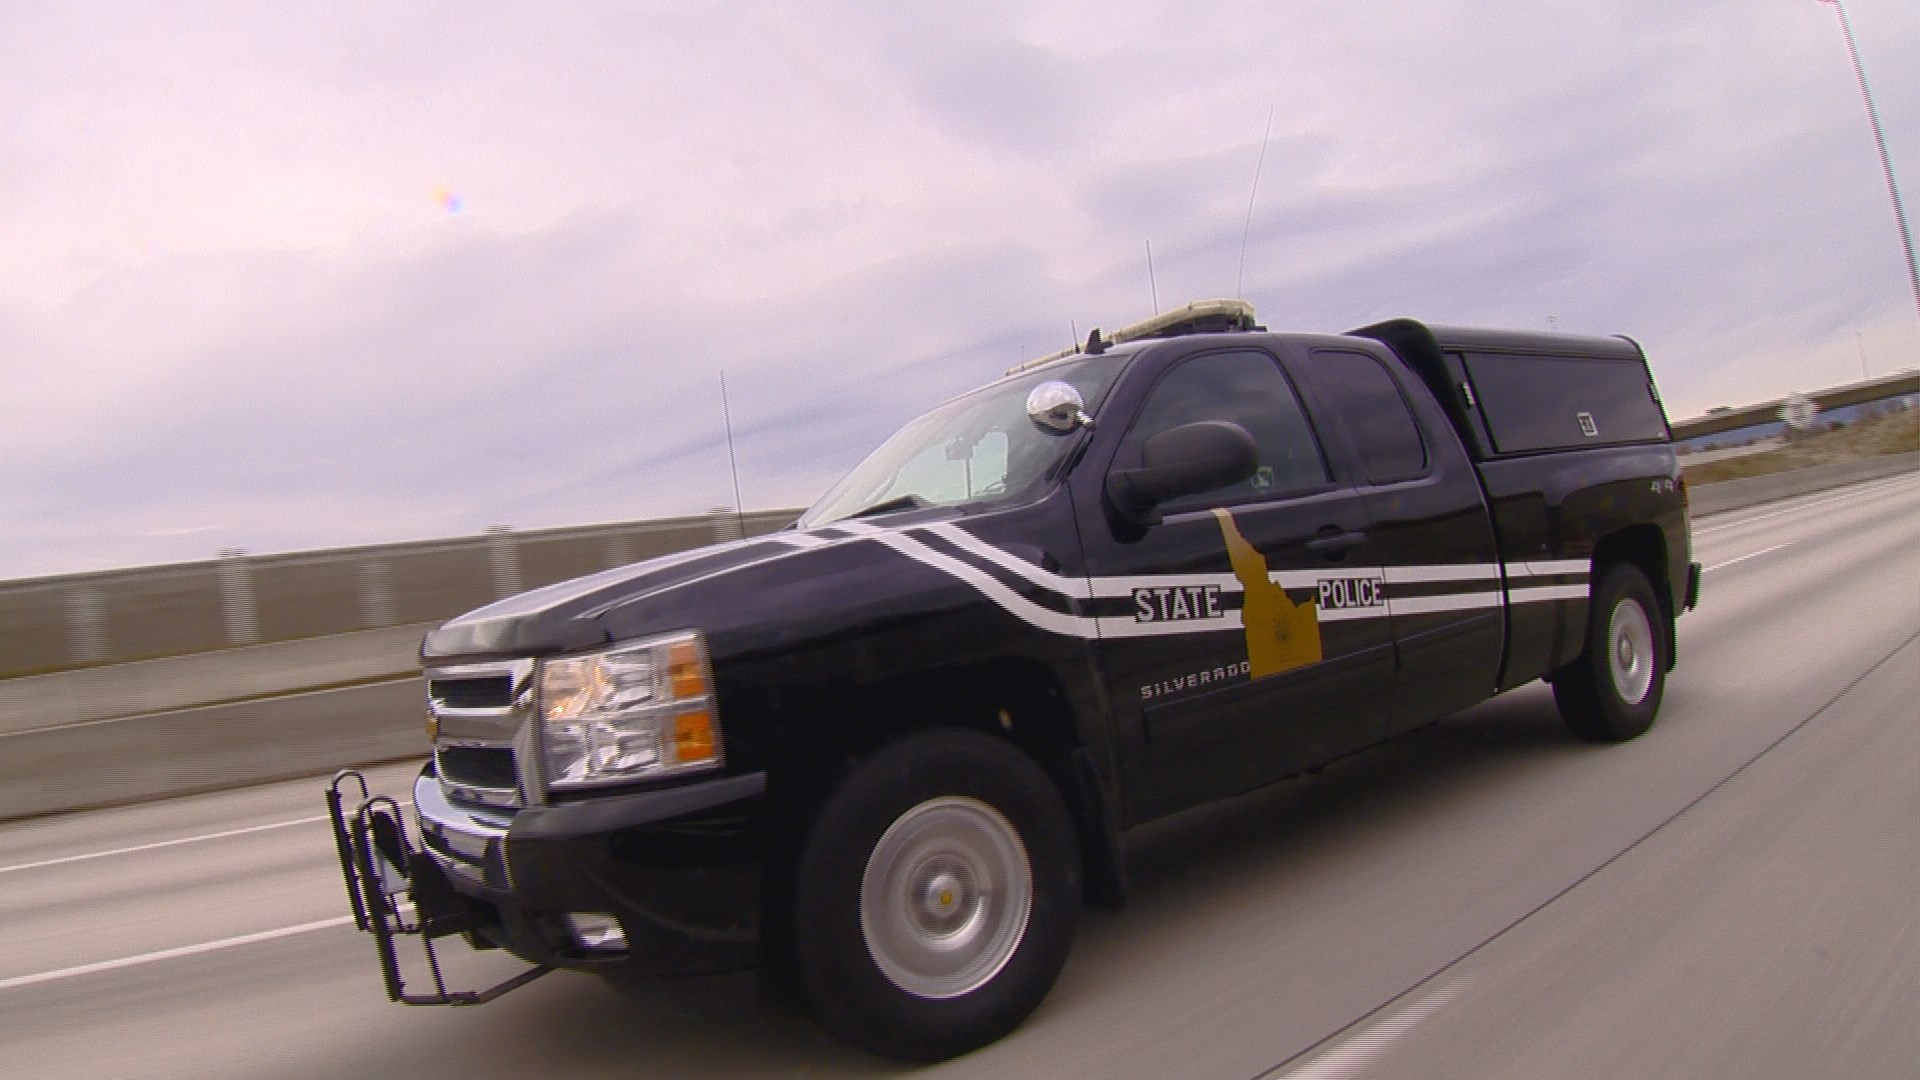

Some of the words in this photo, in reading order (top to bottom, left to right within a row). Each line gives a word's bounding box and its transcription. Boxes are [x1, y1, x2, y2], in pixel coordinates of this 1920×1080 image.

[1650, 479, 1674, 494] 44
[1134, 586, 1222, 622] STATE
[1318, 578, 1382, 609] POLICE
[1140, 661, 1251, 699] SILVERADO
